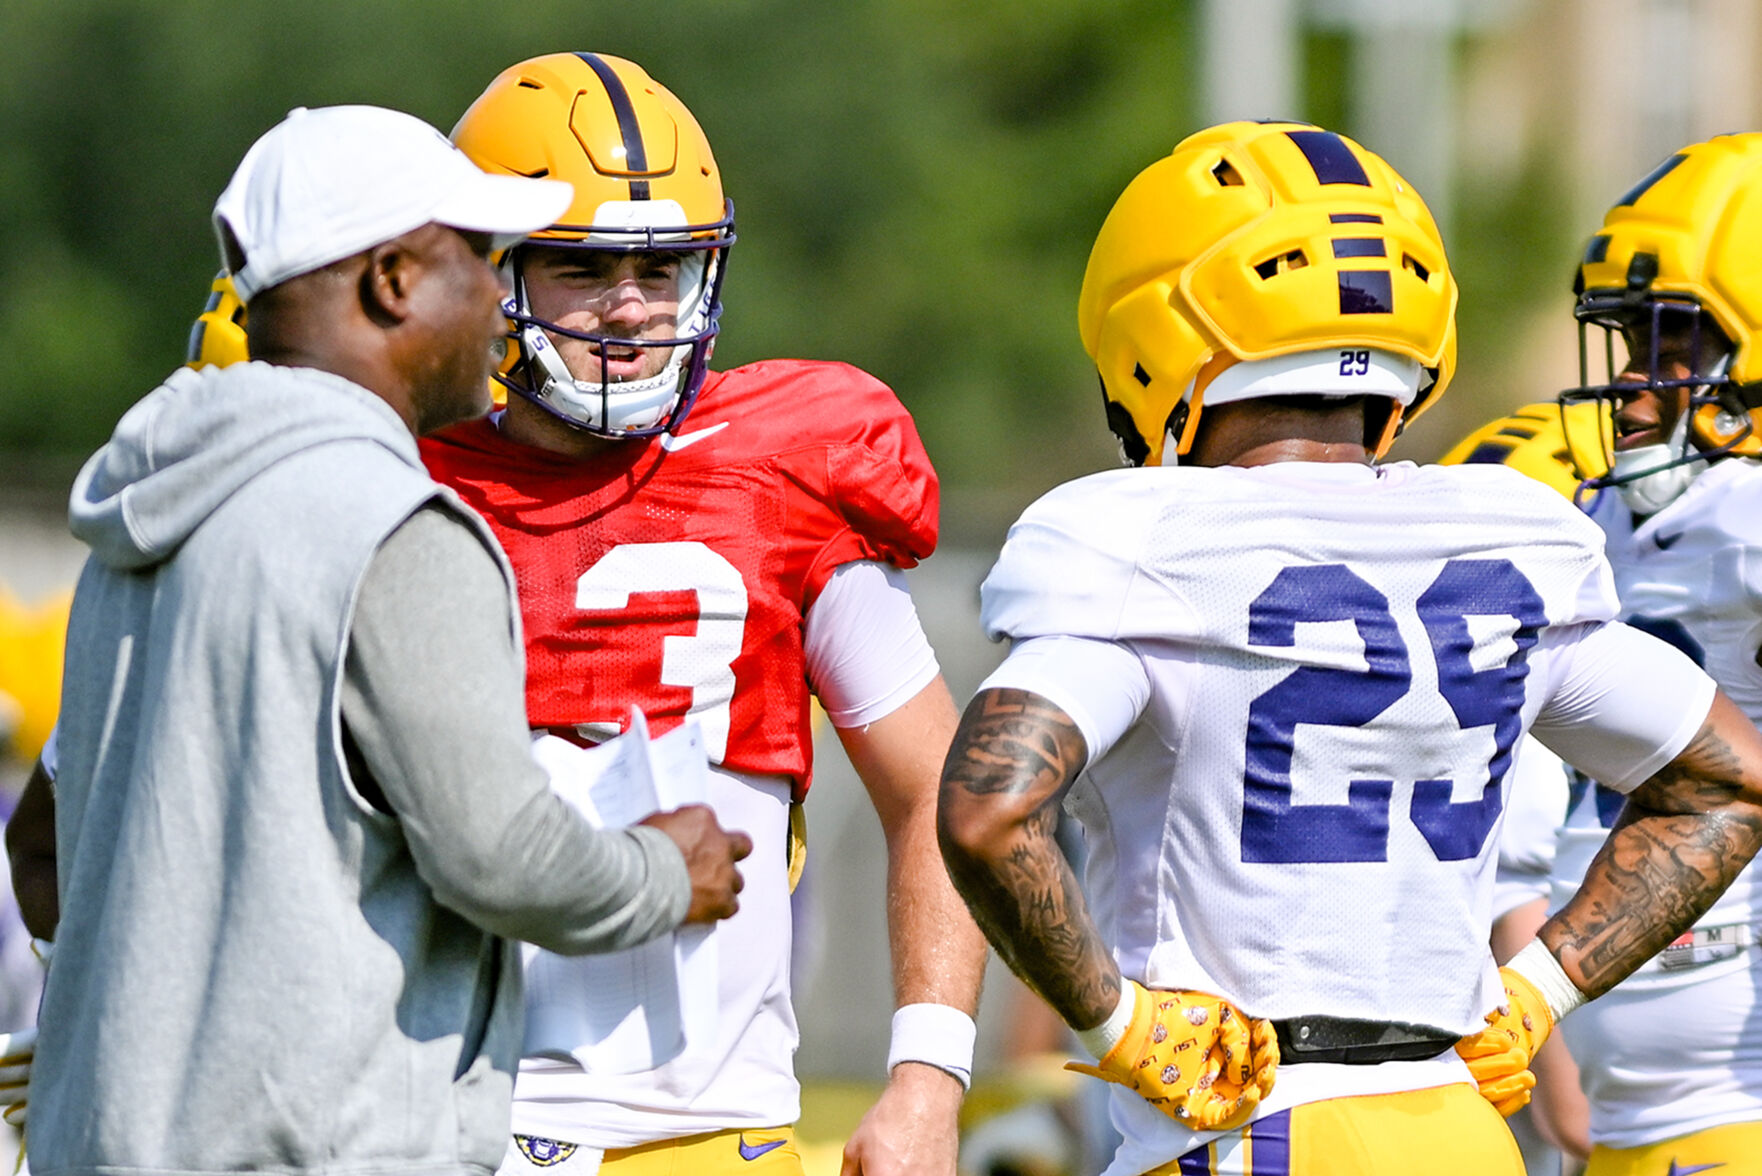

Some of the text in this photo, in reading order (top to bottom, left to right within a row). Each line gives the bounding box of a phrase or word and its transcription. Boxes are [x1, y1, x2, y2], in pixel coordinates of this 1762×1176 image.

[1339, 350, 1370, 376] 29
[575, 541, 748, 765] 3
[1240, 558, 1550, 863] 29
[1174, 1038, 1198, 1055] LSU
